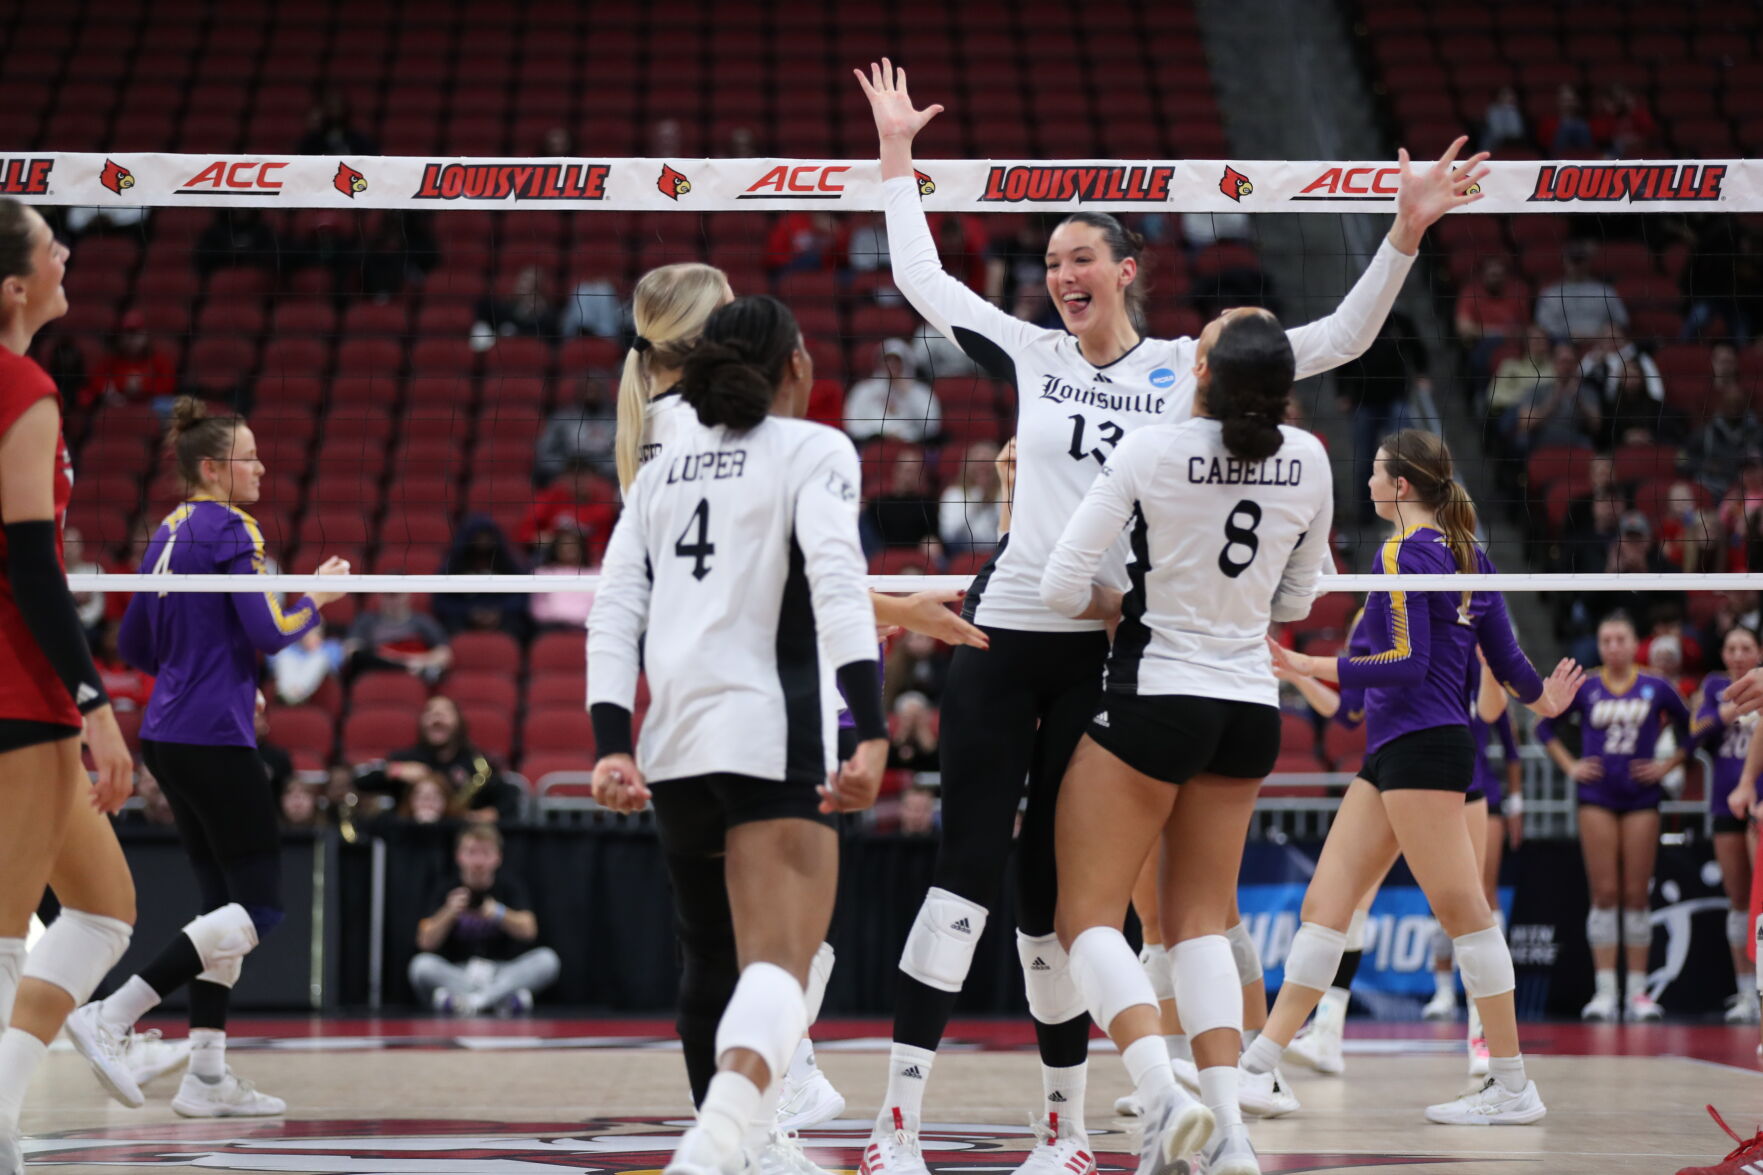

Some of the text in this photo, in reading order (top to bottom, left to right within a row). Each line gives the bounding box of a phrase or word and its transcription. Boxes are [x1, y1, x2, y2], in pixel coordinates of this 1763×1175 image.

[182, 162, 290, 188] ACC
[413, 163, 610, 202] LOUISVILLE
[746, 165, 851, 192] ACC
[979, 166, 1174, 204] LOUISVILLE
[1299, 167, 1401, 193] ACC
[1527, 165, 1725, 204] LOUISVILLE
[1039, 373, 1166, 414] Louisville
[1067, 413, 1125, 467] 13
[666, 448, 747, 485] LUPER
[1187, 456, 1303, 487] CABELLO
[674, 497, 716, 583] 4
[1218, 499, 1263, 579] 8
